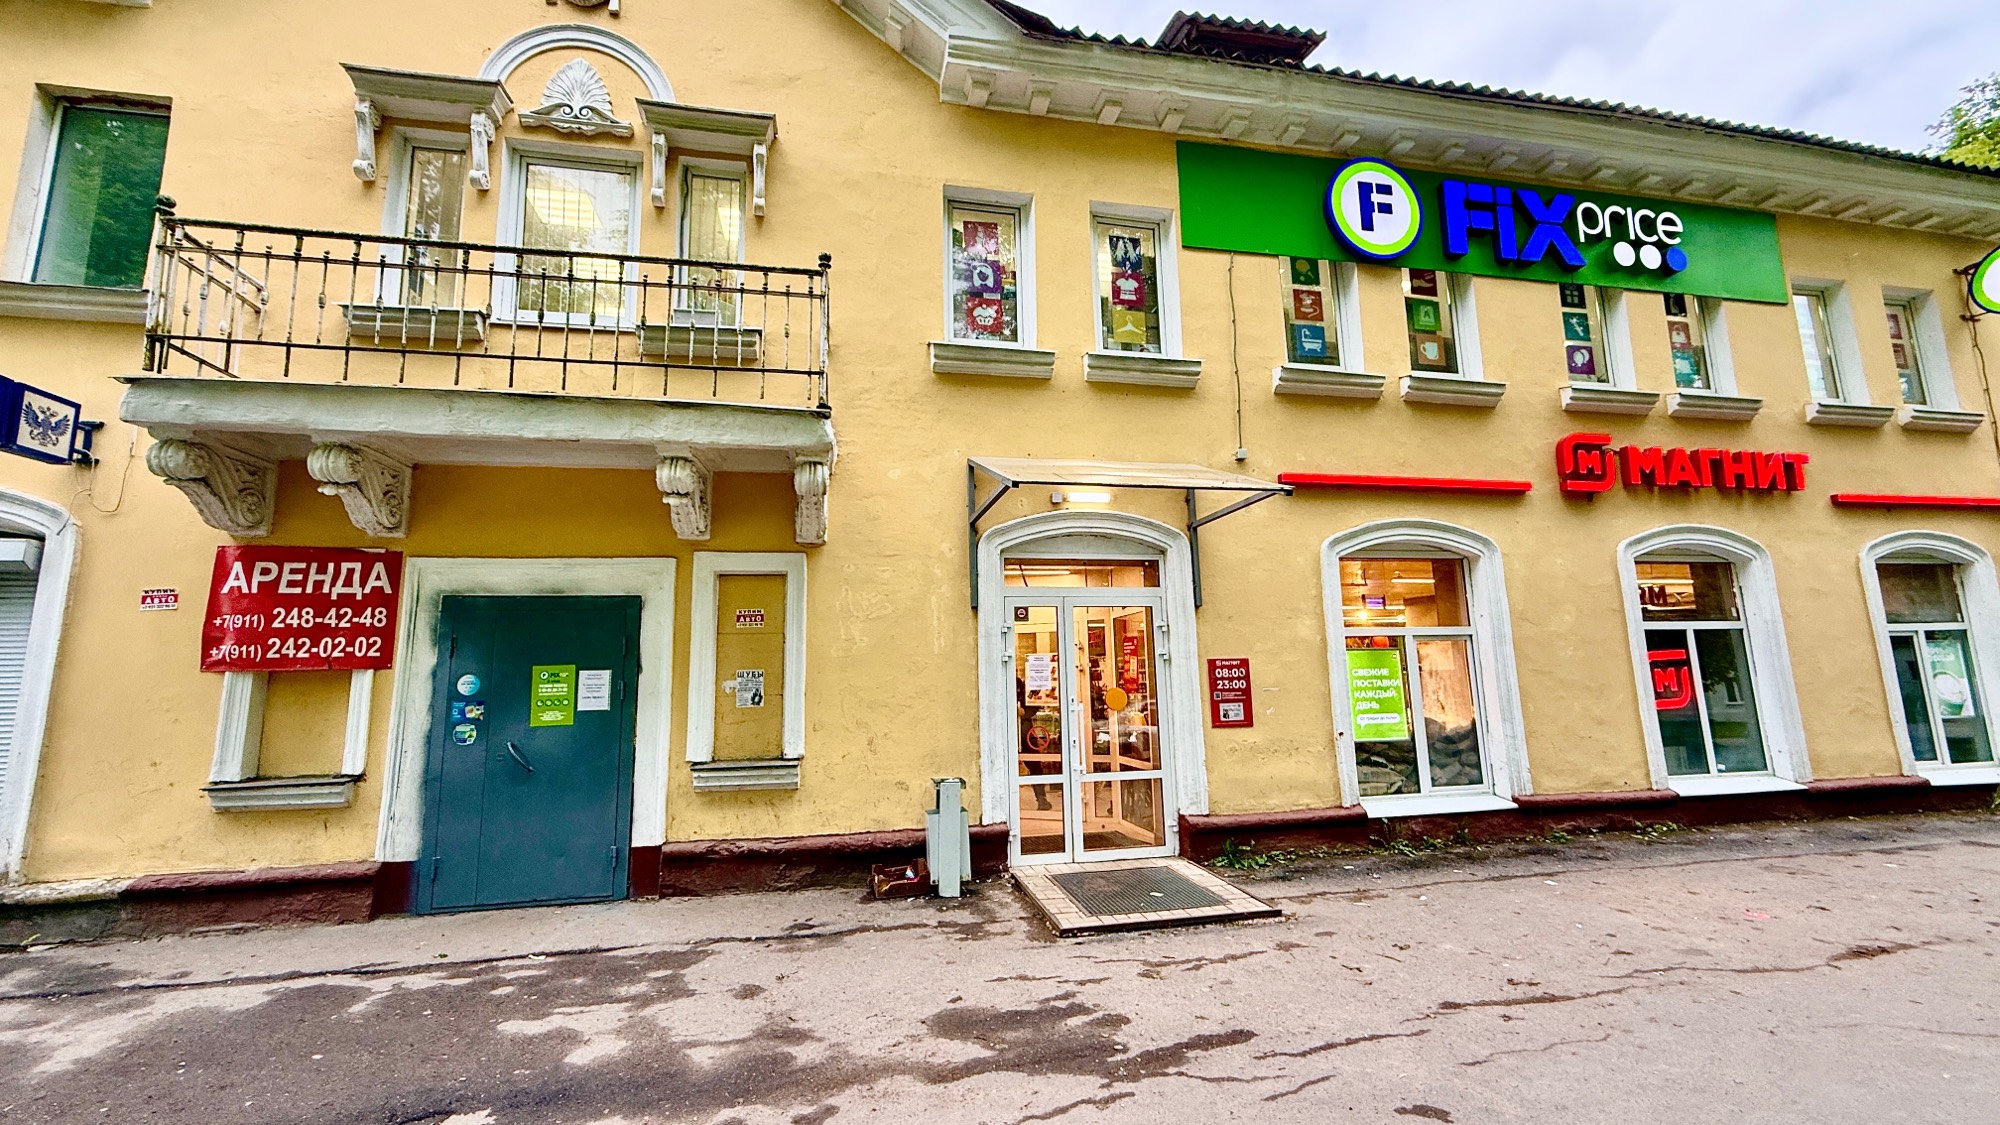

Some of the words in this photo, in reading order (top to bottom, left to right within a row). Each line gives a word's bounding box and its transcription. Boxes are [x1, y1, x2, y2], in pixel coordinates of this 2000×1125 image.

[1357, 180, 1393, 232] F
[1576, 201, 1684, 245] price
[1619, 445, 1811, 491] МАГНИТ
[221, 561, 392, 600] АРЕНДА
[213, 614, 265, 631] +7(911)
[271, 607, 387, 628] 248-42-48
[209, 645, 262, 662] +7(911)
[266, 636, 382, 659] 242-02-02
[737, 671, 763, 679] ШУБЫ
[1215, 668, 1246, 678] 08:00
[1352, 668, 1389, 676] СВЕЖИЕ
[1216, 680, 1247, 689] 23:00
[1353, 679, 1400, 687] ПОСТАВКИ
[1354, 688, 1396, 698] КАЖДЫЙ
[1356, 701, 1379, 710] ДЕНЬ
